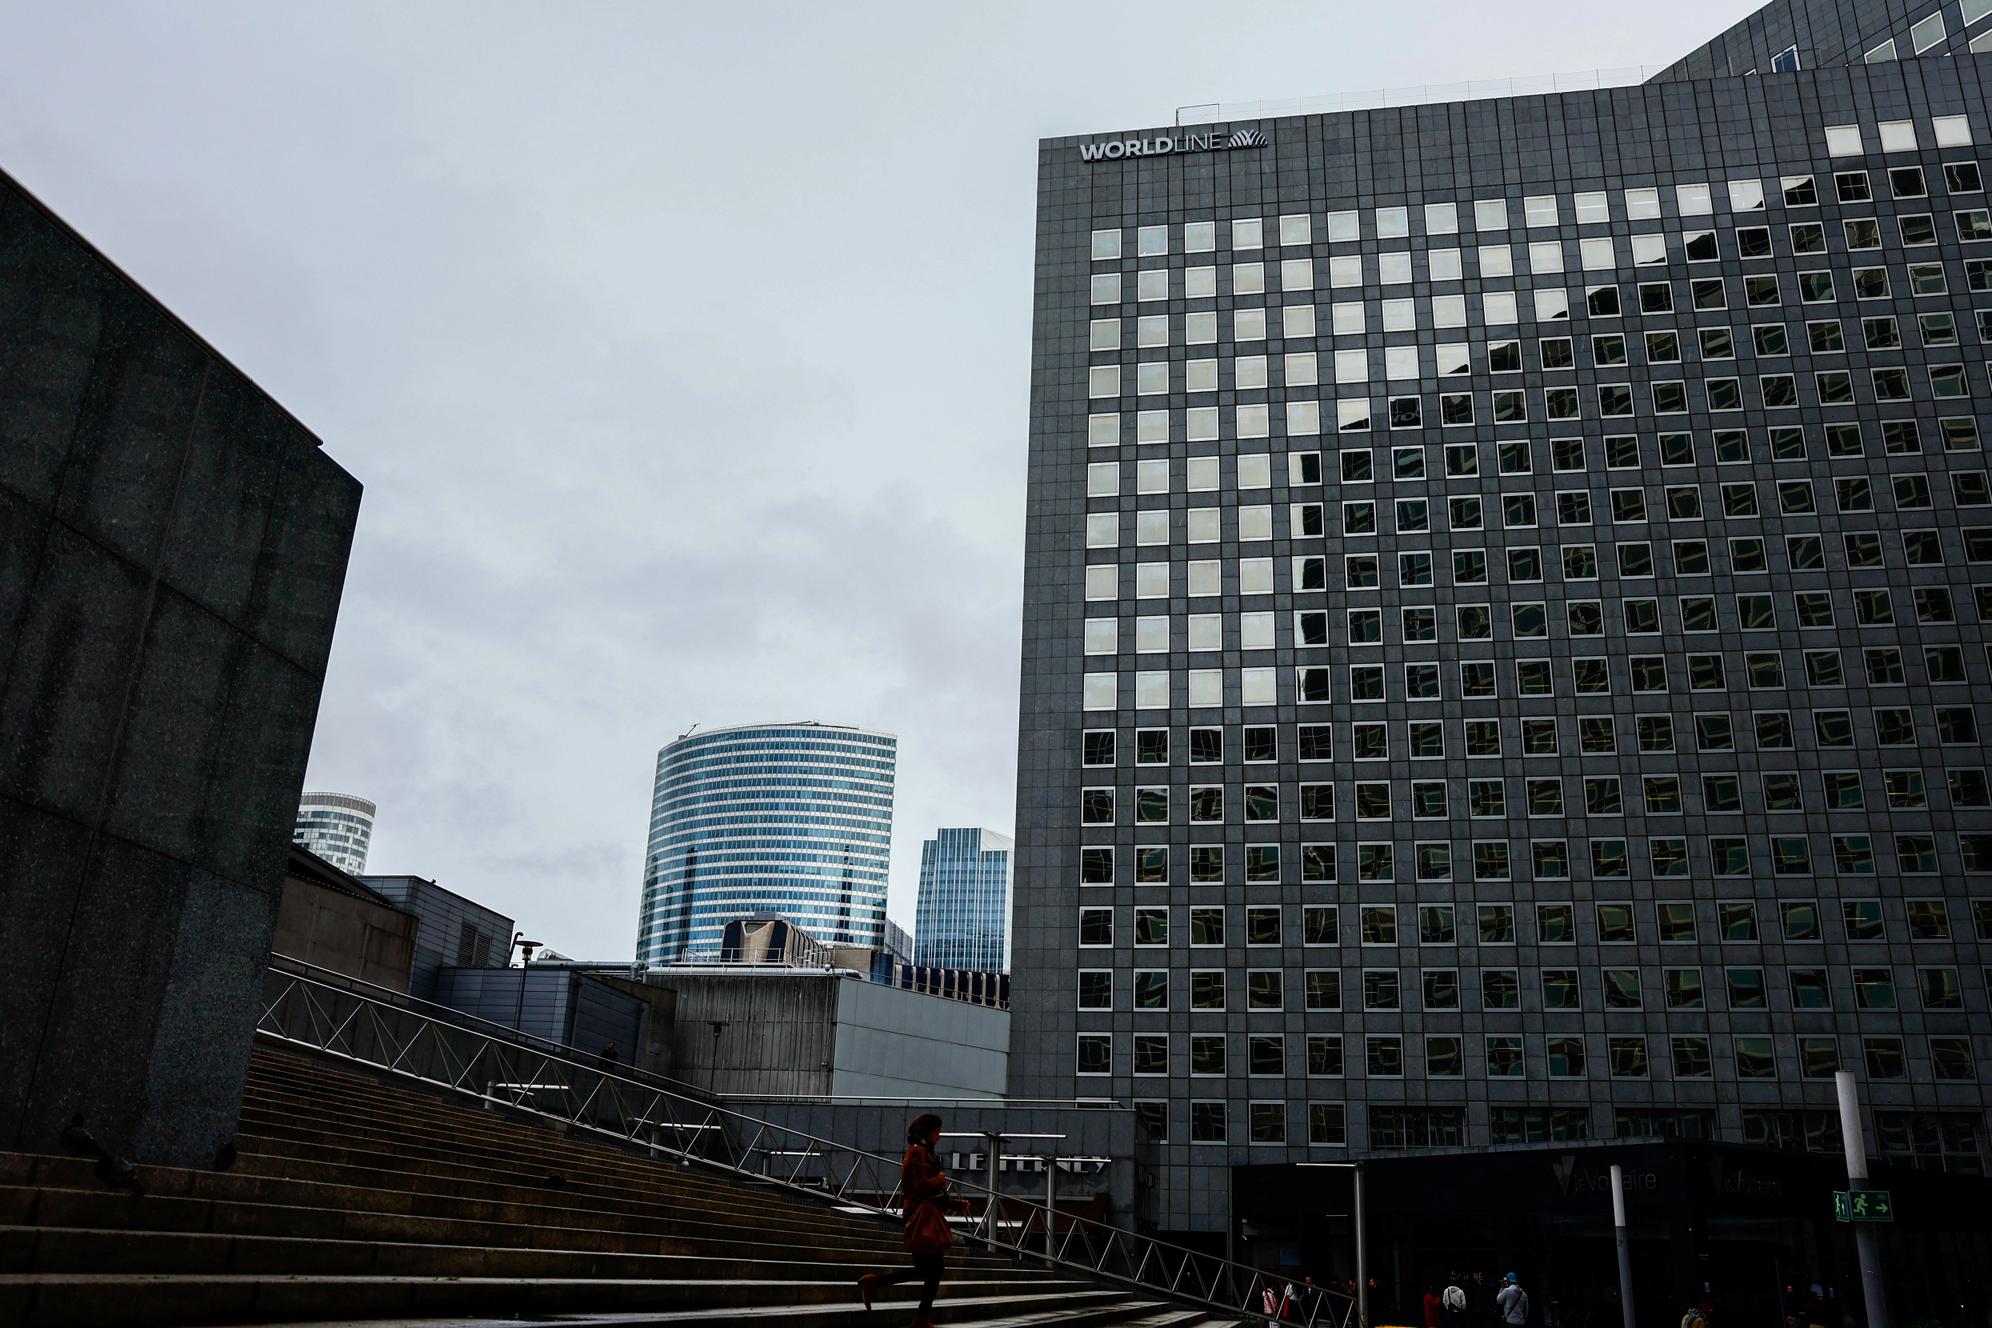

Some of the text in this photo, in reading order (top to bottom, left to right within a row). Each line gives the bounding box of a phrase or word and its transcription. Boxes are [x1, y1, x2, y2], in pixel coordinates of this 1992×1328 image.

[1080, 133, 1222, 161] WORLDLINE
[952, 1152, 985, 1171] LE
[1585, 1168, 1657, 1191] Voaire
